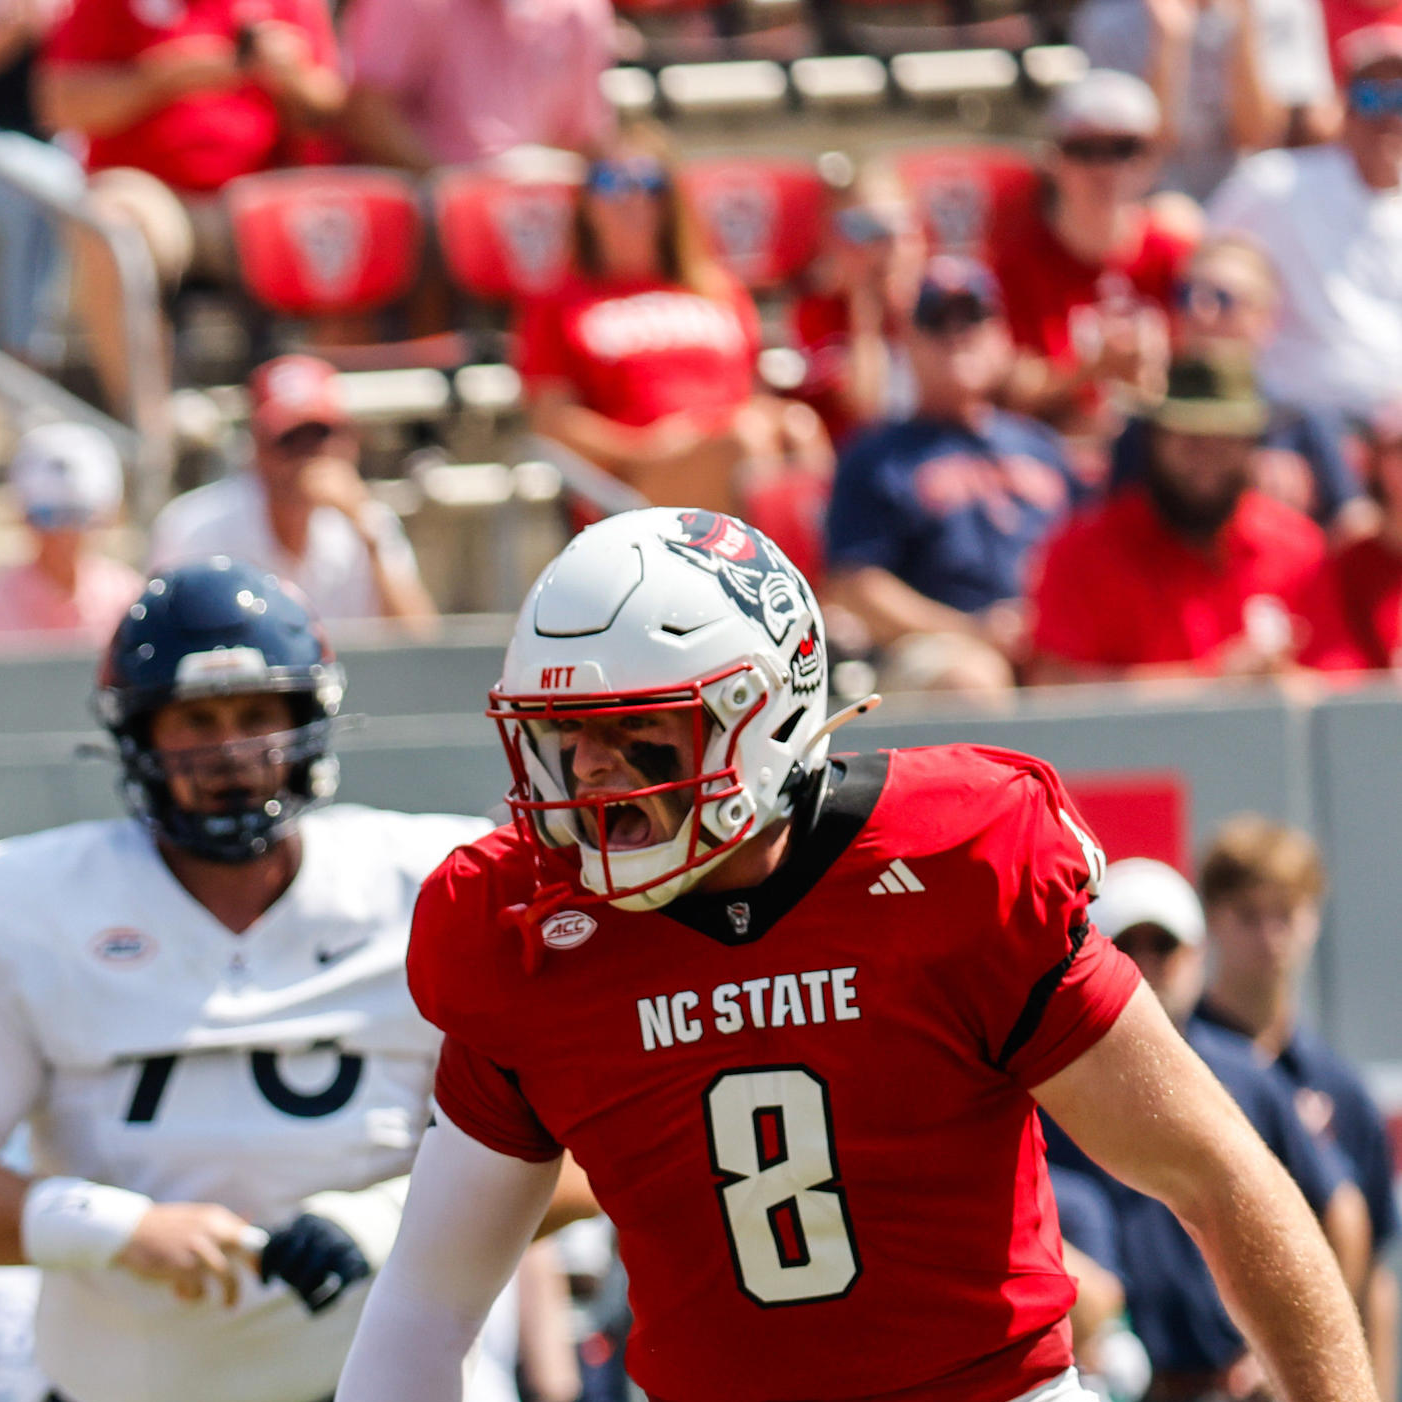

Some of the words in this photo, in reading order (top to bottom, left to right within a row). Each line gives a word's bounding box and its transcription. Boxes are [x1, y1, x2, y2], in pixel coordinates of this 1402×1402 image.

[540, 665, 576, 689] HTT
[636, 989, 704, 1051] NC
[711, 966, 861, 1035] STATE
[701, 1062, 865, 1309] 8
